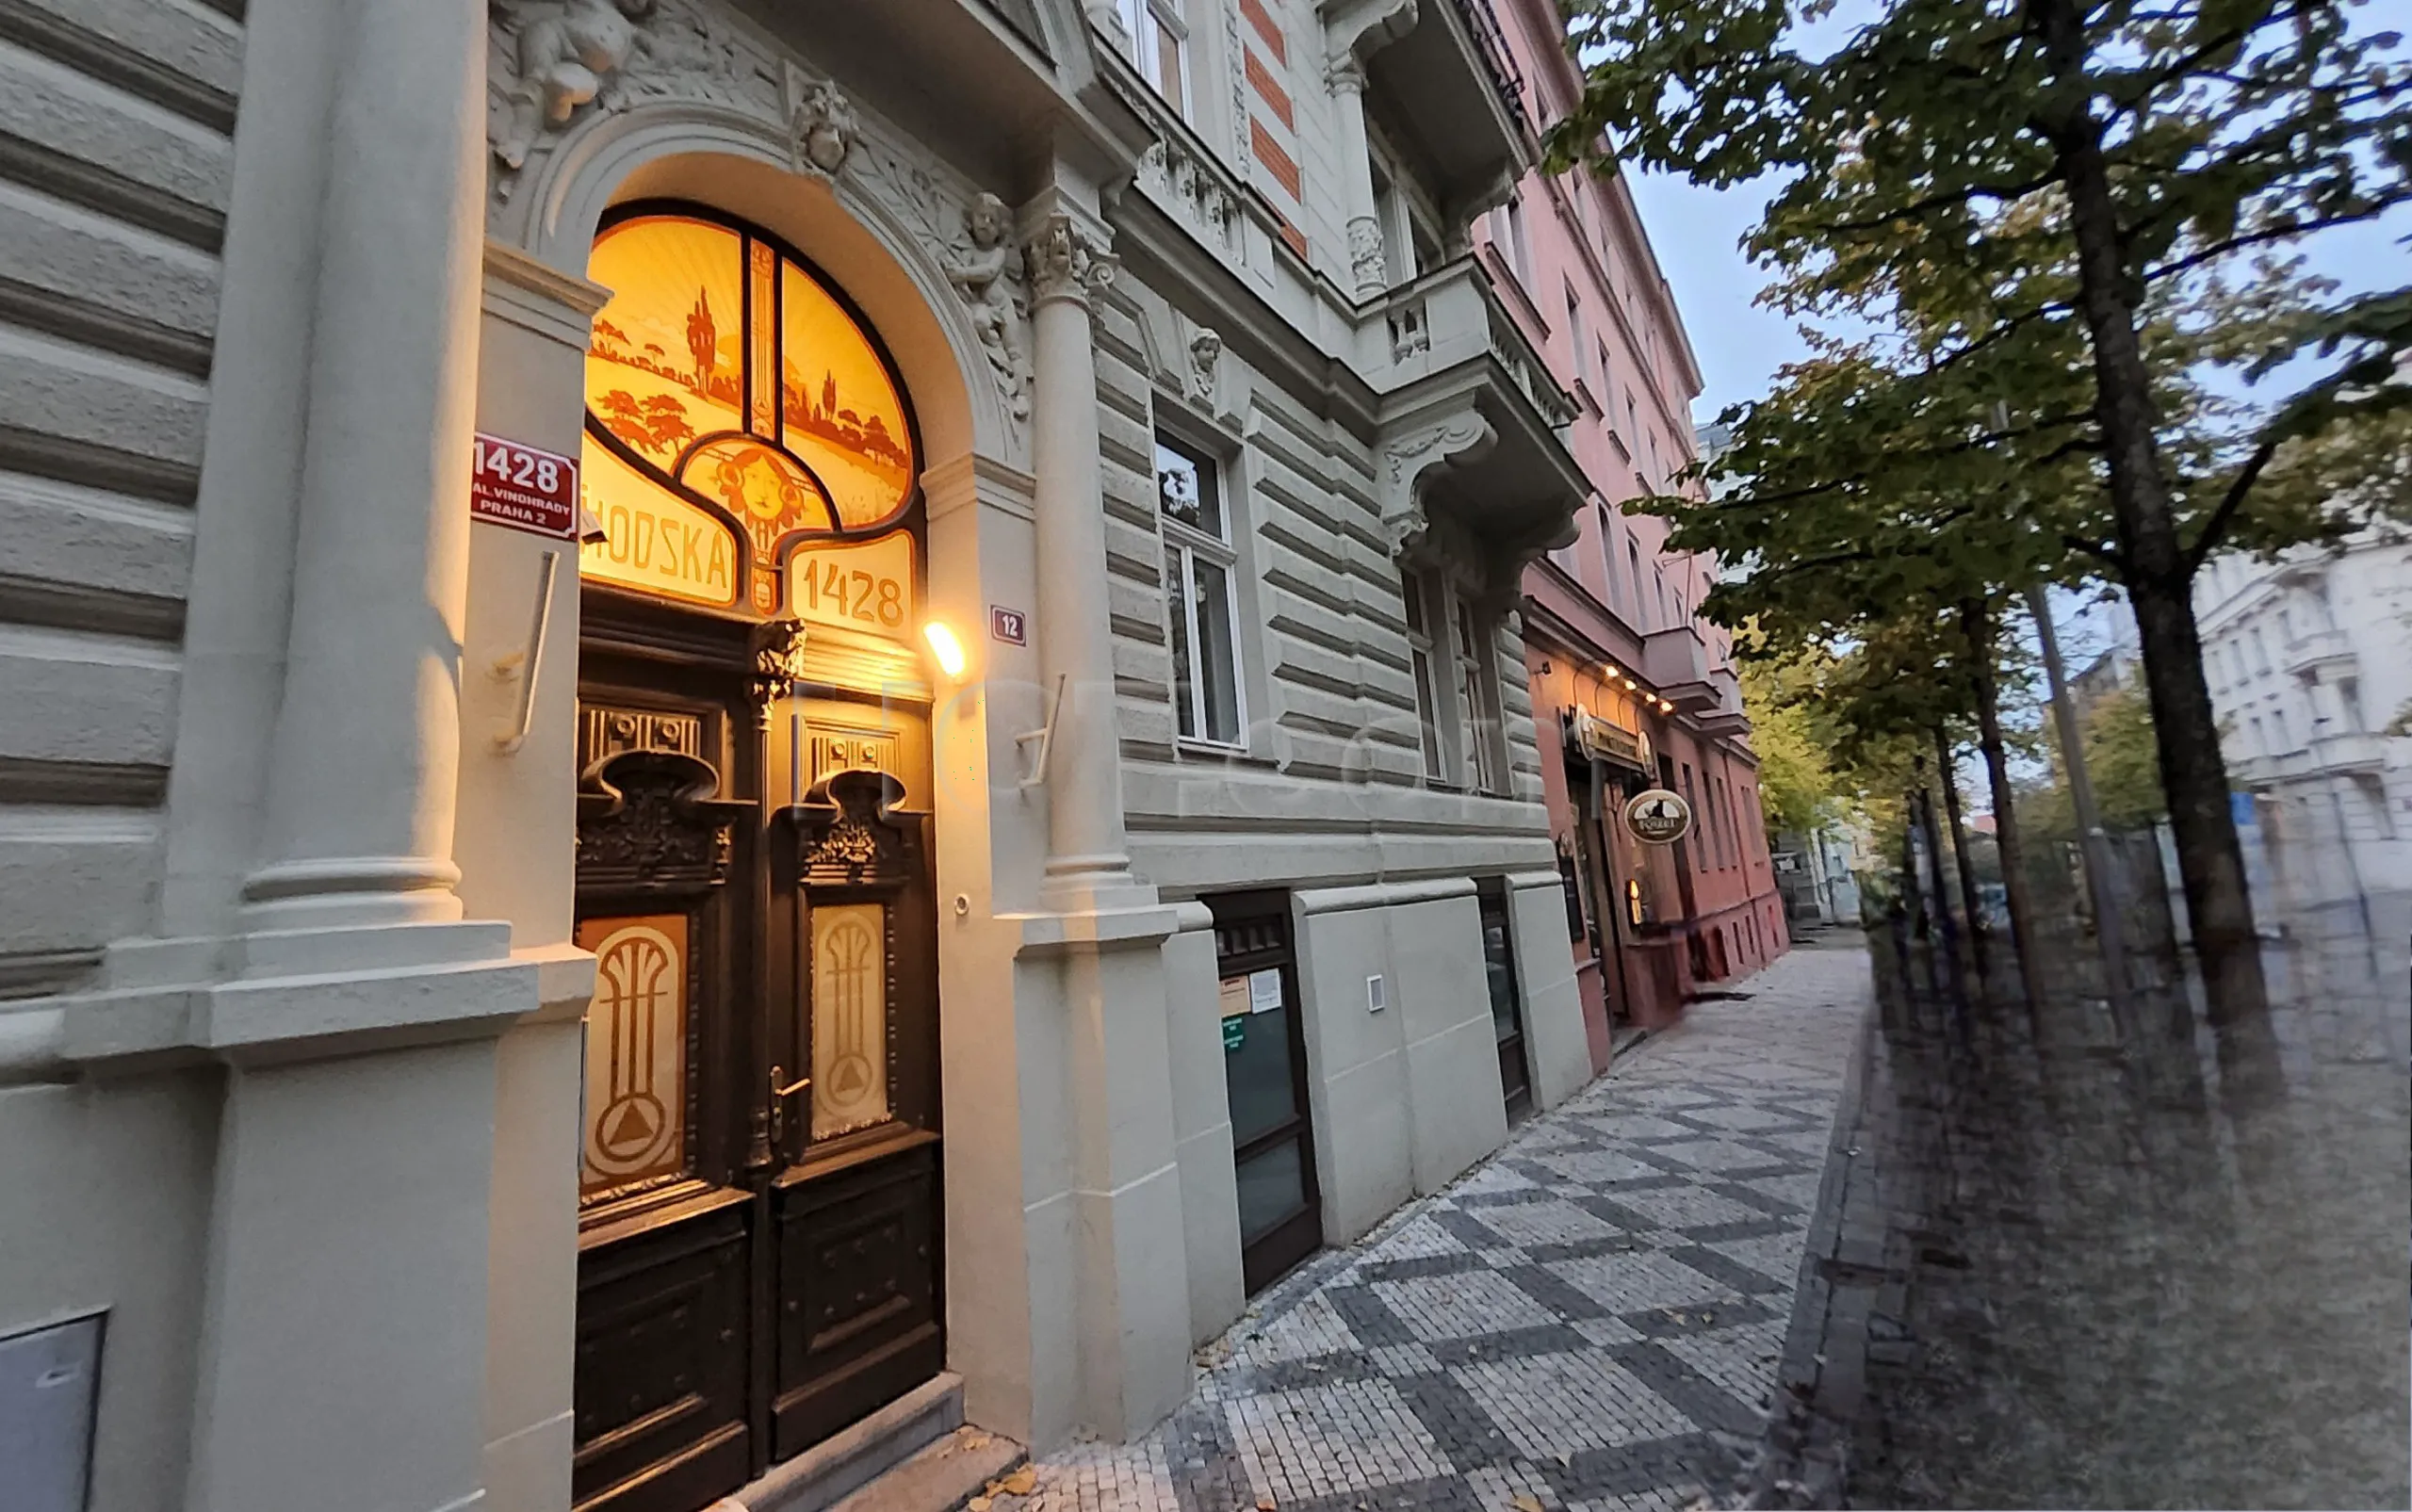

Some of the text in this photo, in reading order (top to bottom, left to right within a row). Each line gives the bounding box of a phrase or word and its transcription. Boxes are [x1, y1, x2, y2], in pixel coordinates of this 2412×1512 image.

[475, 442, 560, 494] 1428
[481, 499, 546, 525] PRAHA 2
[580, 483, 727, 590] HODSKA
[804, 559, 904, 628] 1428
[1002, 614, 1018, 637] 12
